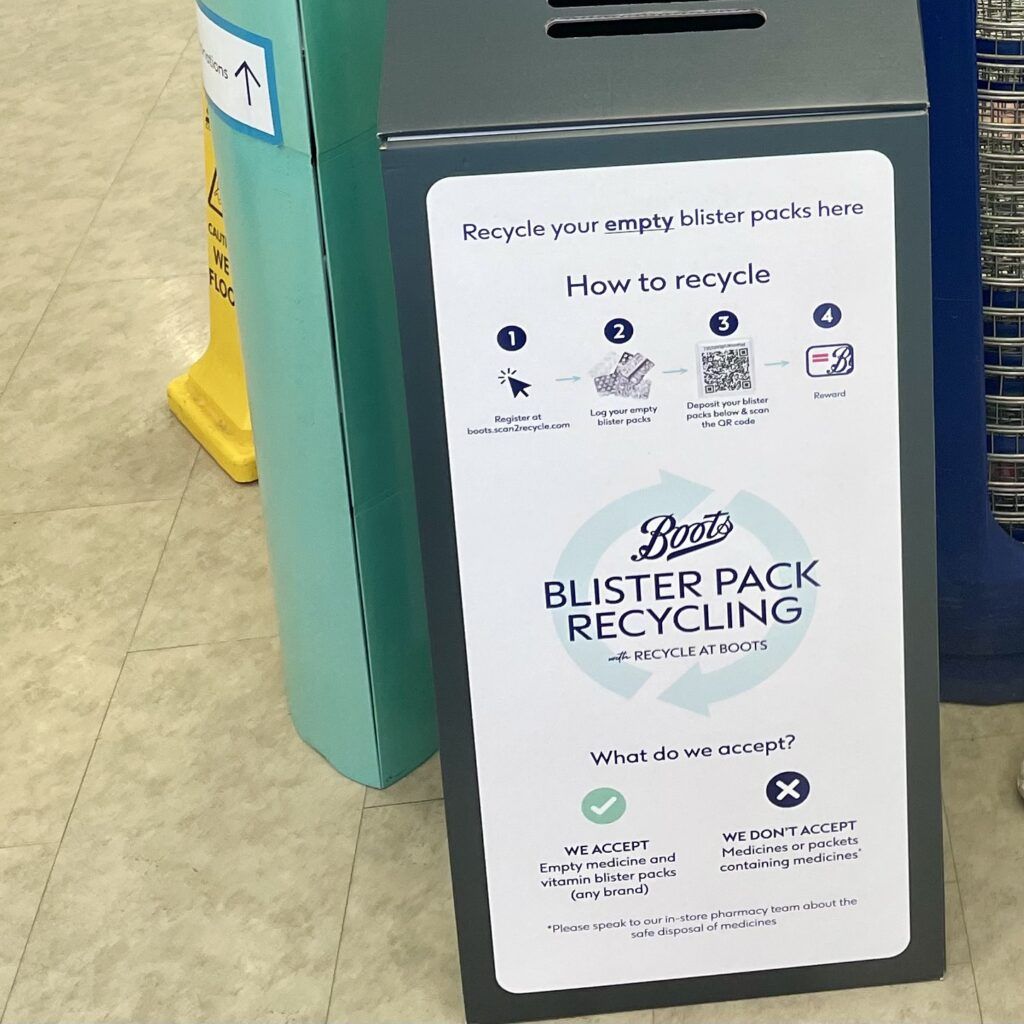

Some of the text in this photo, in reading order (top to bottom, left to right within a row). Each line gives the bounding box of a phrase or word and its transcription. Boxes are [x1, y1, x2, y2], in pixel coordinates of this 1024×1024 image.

[463, 201, 864, 243] Recycle your empty blister packs here
[566, 264, 771, 297] How to recycle
[718, 316, 730, 331] 3
[821, 307, 834, 323] 4
[613, 324, 625, 339] 2
[687, 396, 769, 410] Deposit your blister
[813, 390, 846, 400] Reward
[495, 414, 530, 424] Register
[590, 406, 658, 418] Log your empty
[598, 416, 651, 426] blister packs
[686, 407, 770, 421] packs below & scan
[467, 422, 570, 435] boots.scan2recycle.com
[717, 419, 732, 427] QR
[734, 418, 756, 426] code
[630, 510, 733, 562] Boots
[544, 560, 821, 609] BLISTER PACK
[568, 596, 802, 642] RECYCLING
[608, 640, 768, 662] with RECYCLE AT BOOTS
[590, 735, 796, 766] What do we accept?
[723, 821, 857, 843] WE DON'T ACCEPT
[564, 840, 649, 856] WE ACCEPT
[722, 836, 859, 858] Medicines or packets
[539, 852, 676, 875] Empty medicine and
[720, 856, 789, 873] containing
[541, 867, 677, 888] vitamin blister packs
[570, 883, 649, 902] (any brand)
[593, 919, 627, 933] speak
[630, 918, 641, 927] to
[643, 916, 663, 925] our
[665, 911, 708, 924] in-store
[710, 906, 769, 921] pharmacy
[771, 903, 800, 914] team
[803, 899, 837, 911] about
[839, 896, 858, 907] the
[631, 917, 777, 939] safe disposal of medicines
